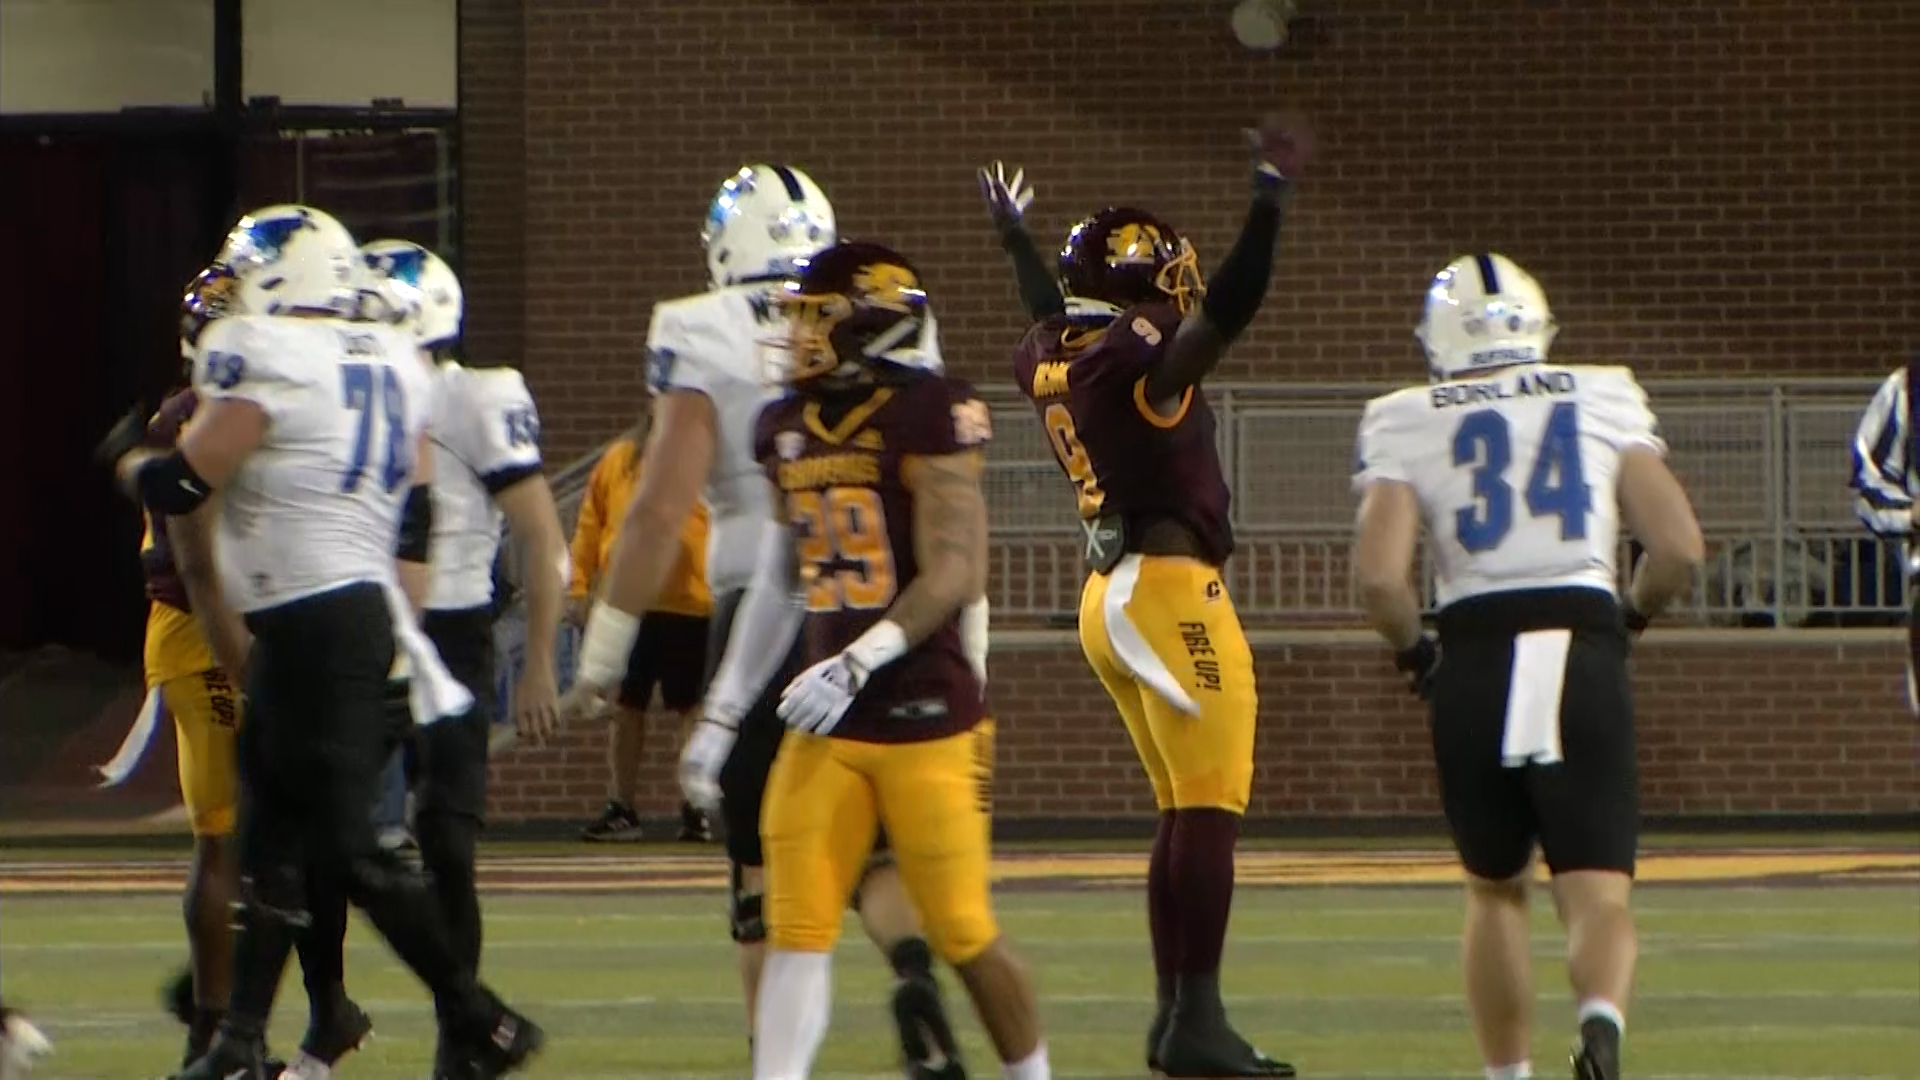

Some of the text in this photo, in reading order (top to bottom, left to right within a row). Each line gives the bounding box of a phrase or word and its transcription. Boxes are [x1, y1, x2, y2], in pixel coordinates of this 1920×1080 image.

[1132, 316, 1162, 346] 9
[1431, 371, 1577, 409] BORLAND
[1452, 402, 1592, 554] 34
[788, 486, 897, 612] 29
[1206, 581, 1220, 598] C
[1178, 621, 1222, 692] FIRE UP!
